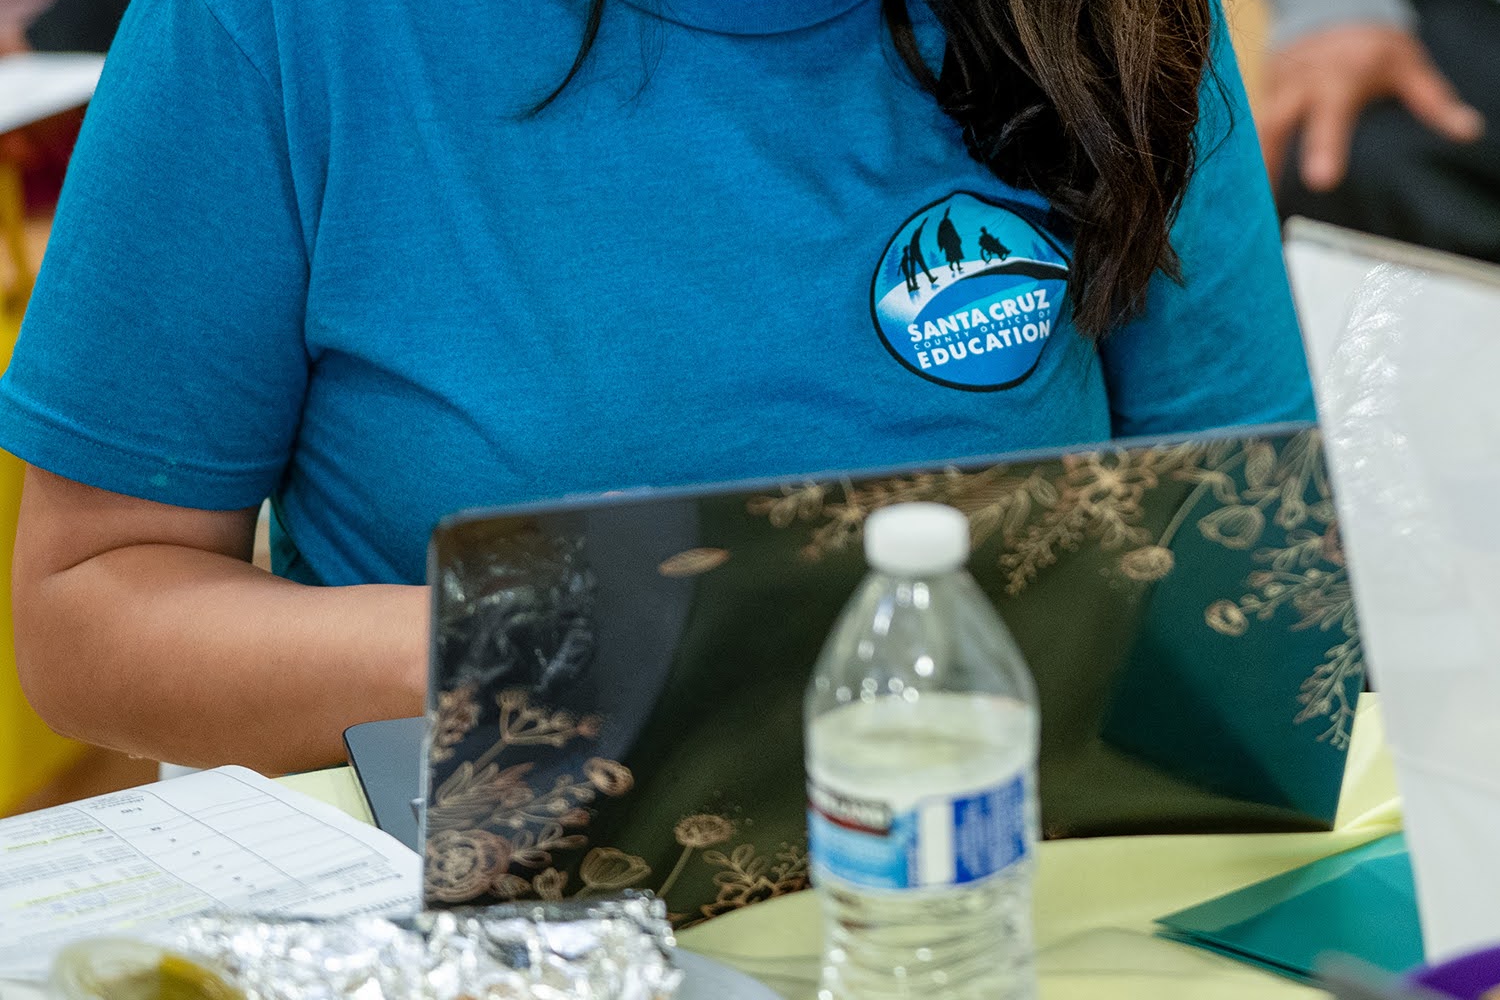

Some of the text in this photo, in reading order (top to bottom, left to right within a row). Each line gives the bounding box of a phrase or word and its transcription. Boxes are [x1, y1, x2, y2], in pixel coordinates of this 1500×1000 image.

[907, 289, 1050, 342] SANTA CRUZ
[913, 331, 969, 350] COUNTY
[980, 314, 1029, 332] OFFICE
[917, 319, 1050, 369] EDUCATION
